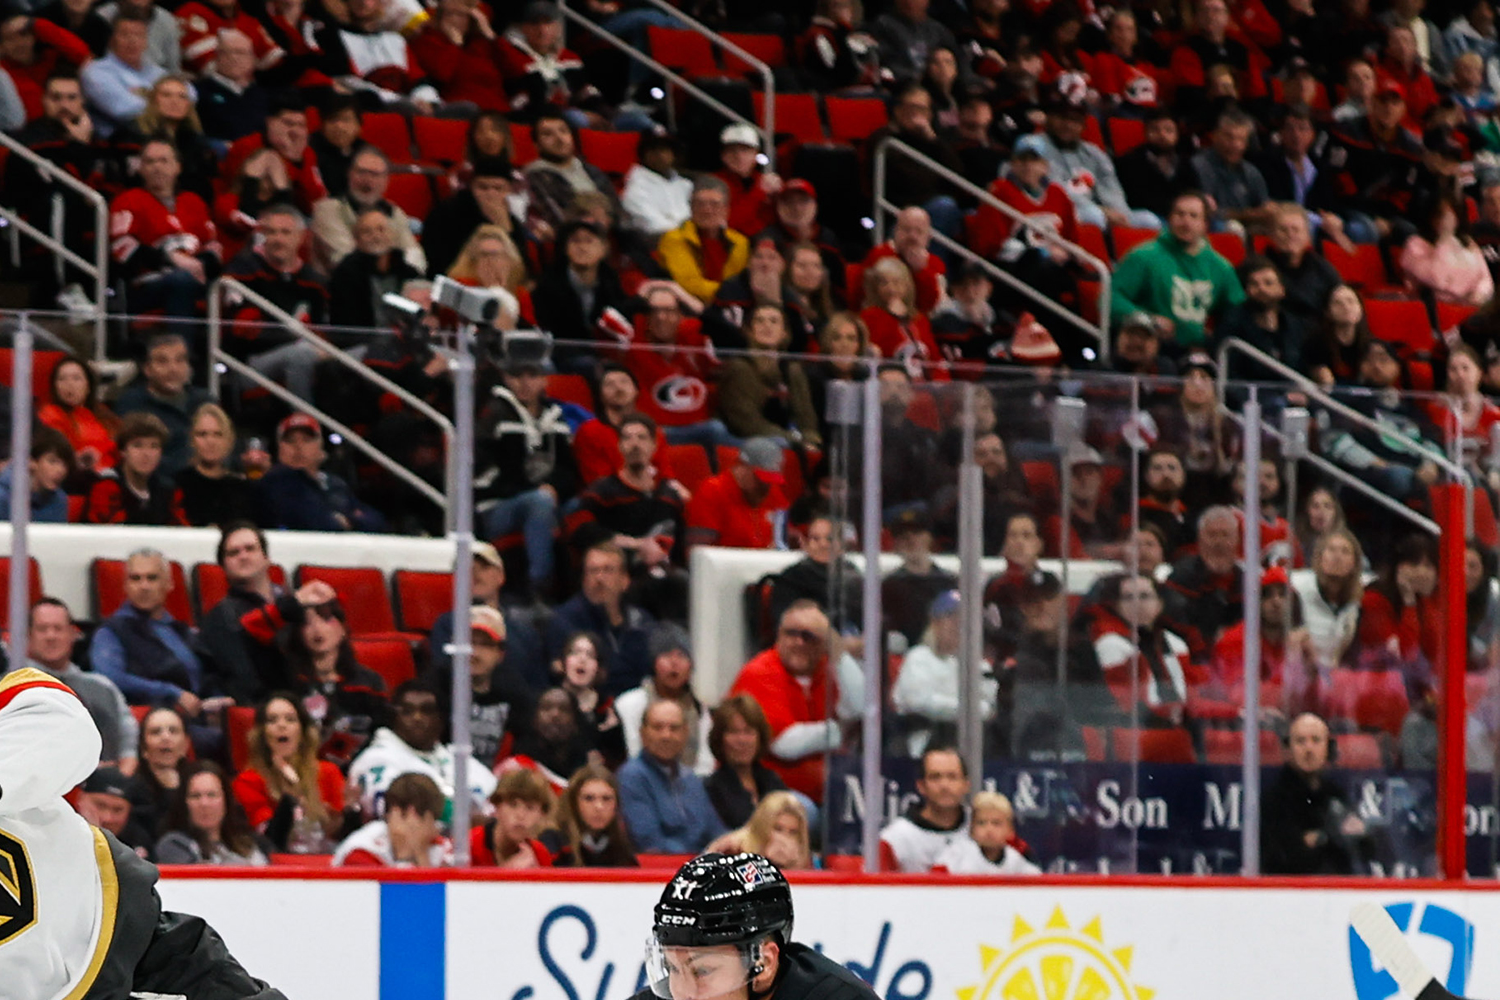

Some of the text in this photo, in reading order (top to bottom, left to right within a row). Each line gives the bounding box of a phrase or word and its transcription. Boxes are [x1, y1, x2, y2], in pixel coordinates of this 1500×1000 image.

[1095, 780, 1168, 829] Son
[1463, 804, 1499, 837] on
[660, 914, 697, 926] CCM
